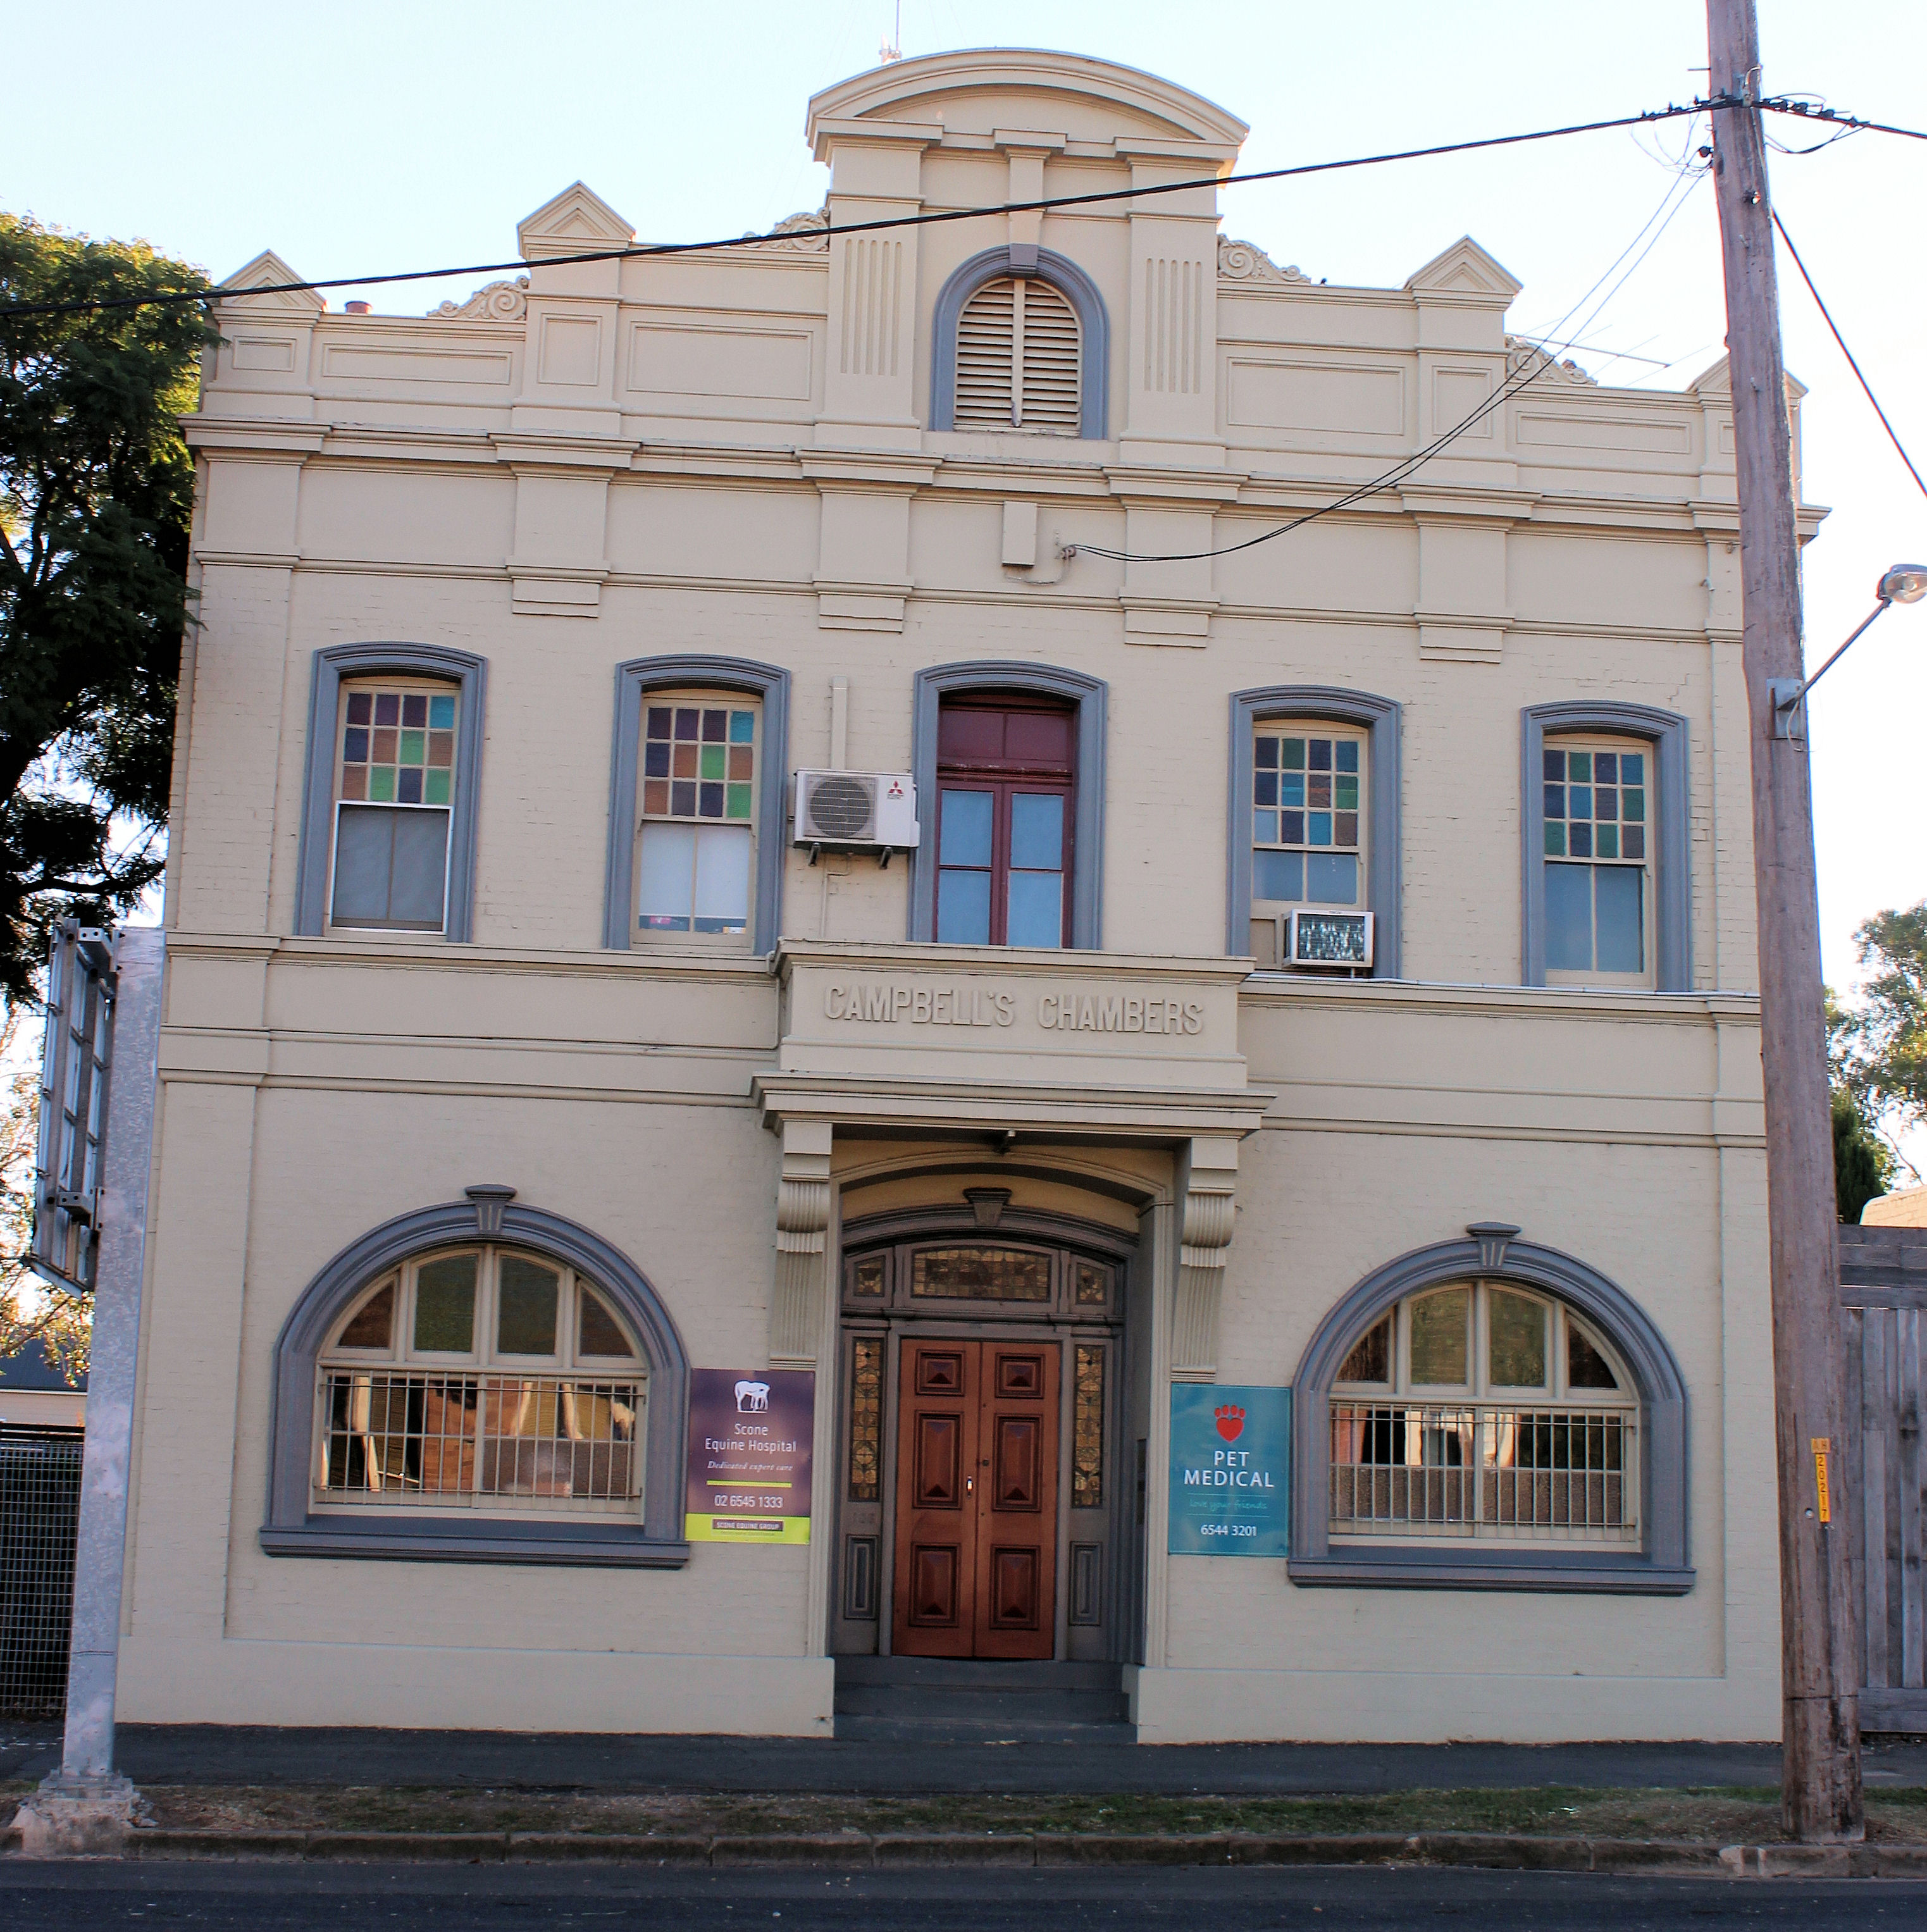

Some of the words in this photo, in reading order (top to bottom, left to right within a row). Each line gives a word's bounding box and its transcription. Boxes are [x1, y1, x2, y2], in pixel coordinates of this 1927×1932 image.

[824, 985, 1014, 1027] CAMPBELL'S
[1038, 993, 1203, 1034] CHAMBERS
[734, 1423, 769, 1435] Scone
[705, 1438, 745, 1452] Equine
[748, 1439, 797, 1454] Hospital
[1214, 1451, 1250, 1466] PET
[707, 1461, 748, 1470] Dedicated
[749, 1464, 774, 1473] expert
[1184, 1470, 1275, 1488] MEDICAL
[1818, 1456, 1828, 1519] 20217
[714, 1495, 727, 1506] 02
[729, 1495, 755, 1507] 6545
[759, 1497, 783, 1508] 1333
[1201, 1525, 1229, 1535] 6544
[1231, 1526, 1257, 1537] 3201
